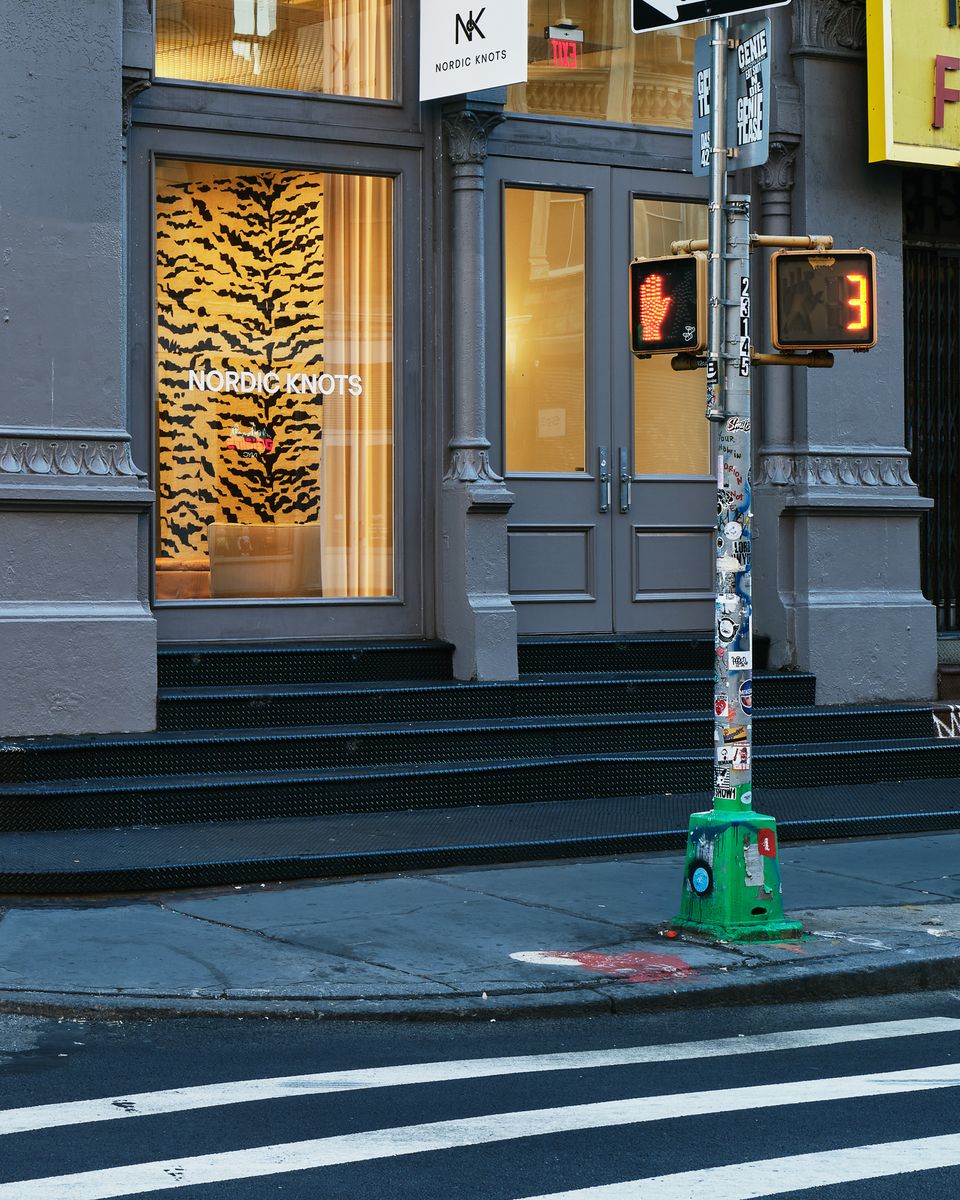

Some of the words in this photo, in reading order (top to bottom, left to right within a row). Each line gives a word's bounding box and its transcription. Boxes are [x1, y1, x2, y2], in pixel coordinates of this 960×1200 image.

[435, 56, 472, 73] NORDIC
[475, 49, 508, 65] KNOTS
[737, 29, 767, 70] GENIE
[737, 93, 764, 123] GENIE
[845, 274, 868, 331] 3
[188, 369, 280, 395] NORDIC
[285, 372, 363, 397] KNOTS
